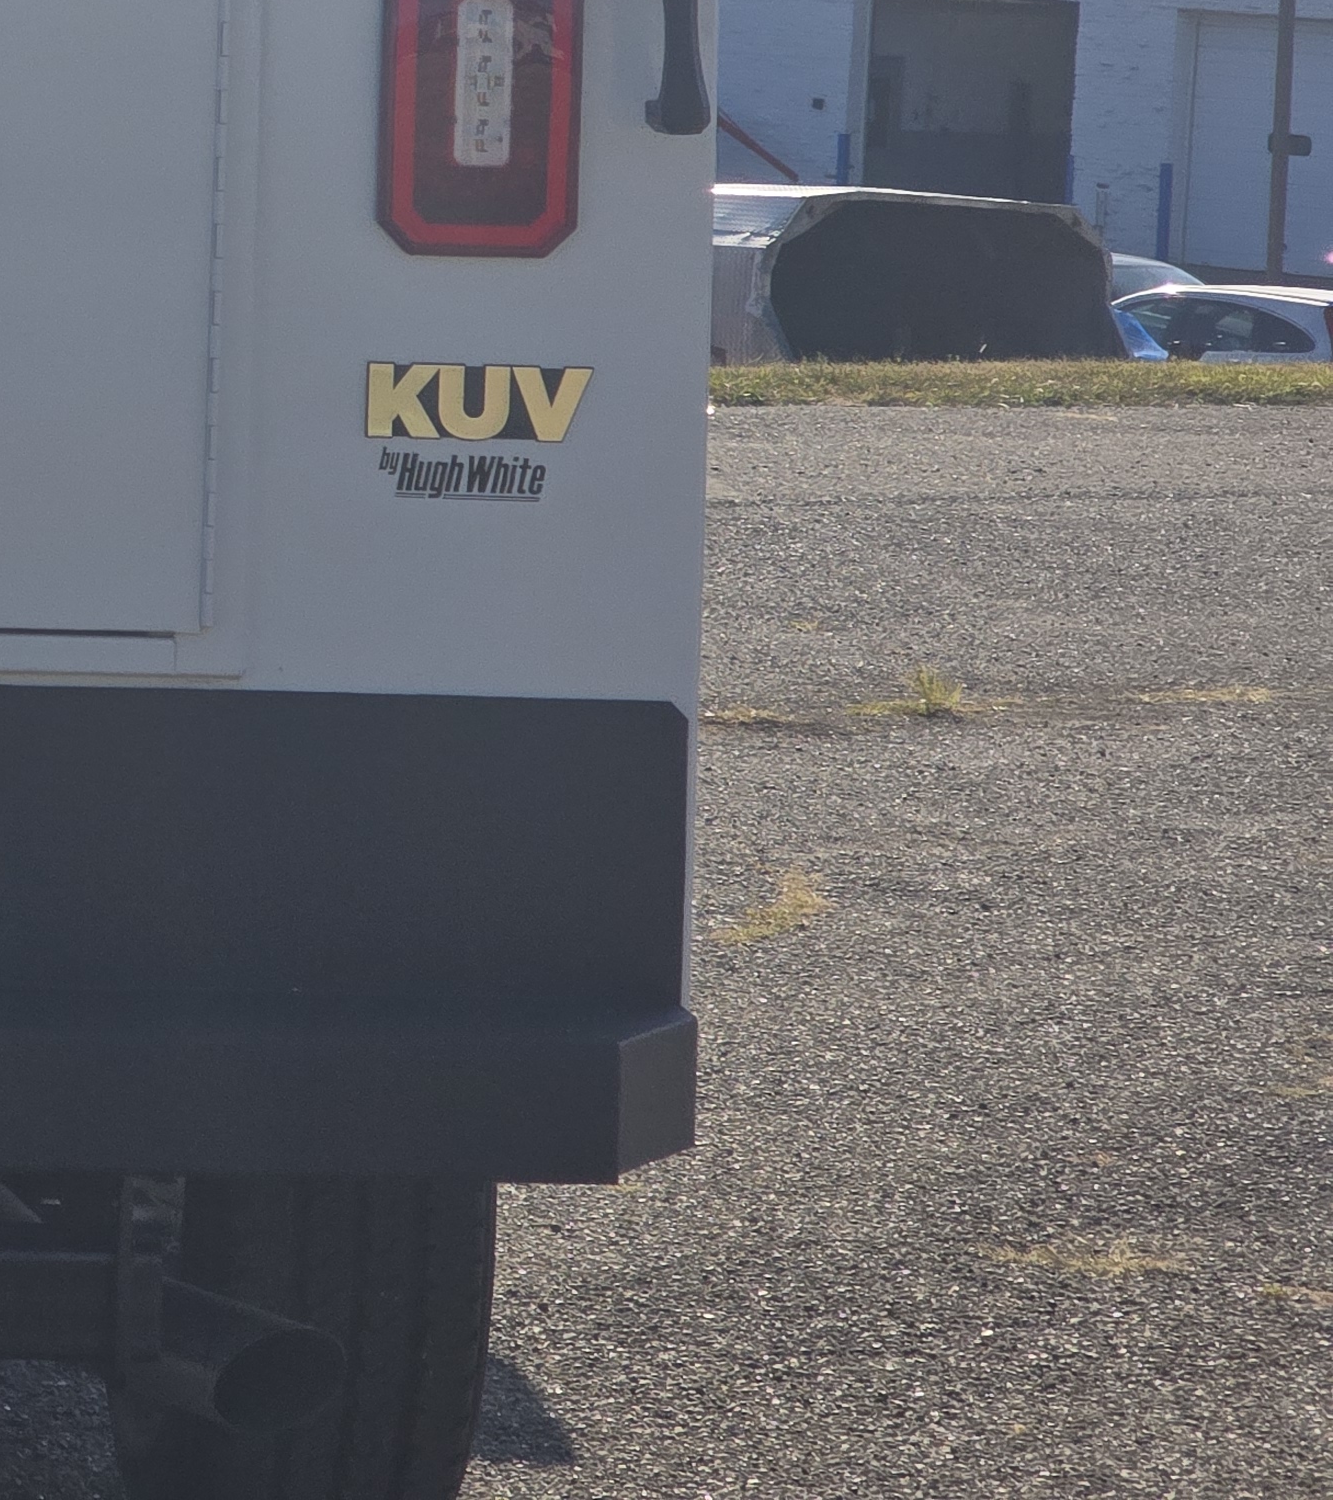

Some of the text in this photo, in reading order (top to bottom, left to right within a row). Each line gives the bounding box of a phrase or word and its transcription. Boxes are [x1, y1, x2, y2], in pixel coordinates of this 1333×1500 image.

[366, 361, 594, 443] KUV
[378, 447, 546, 498] by Hugh White
